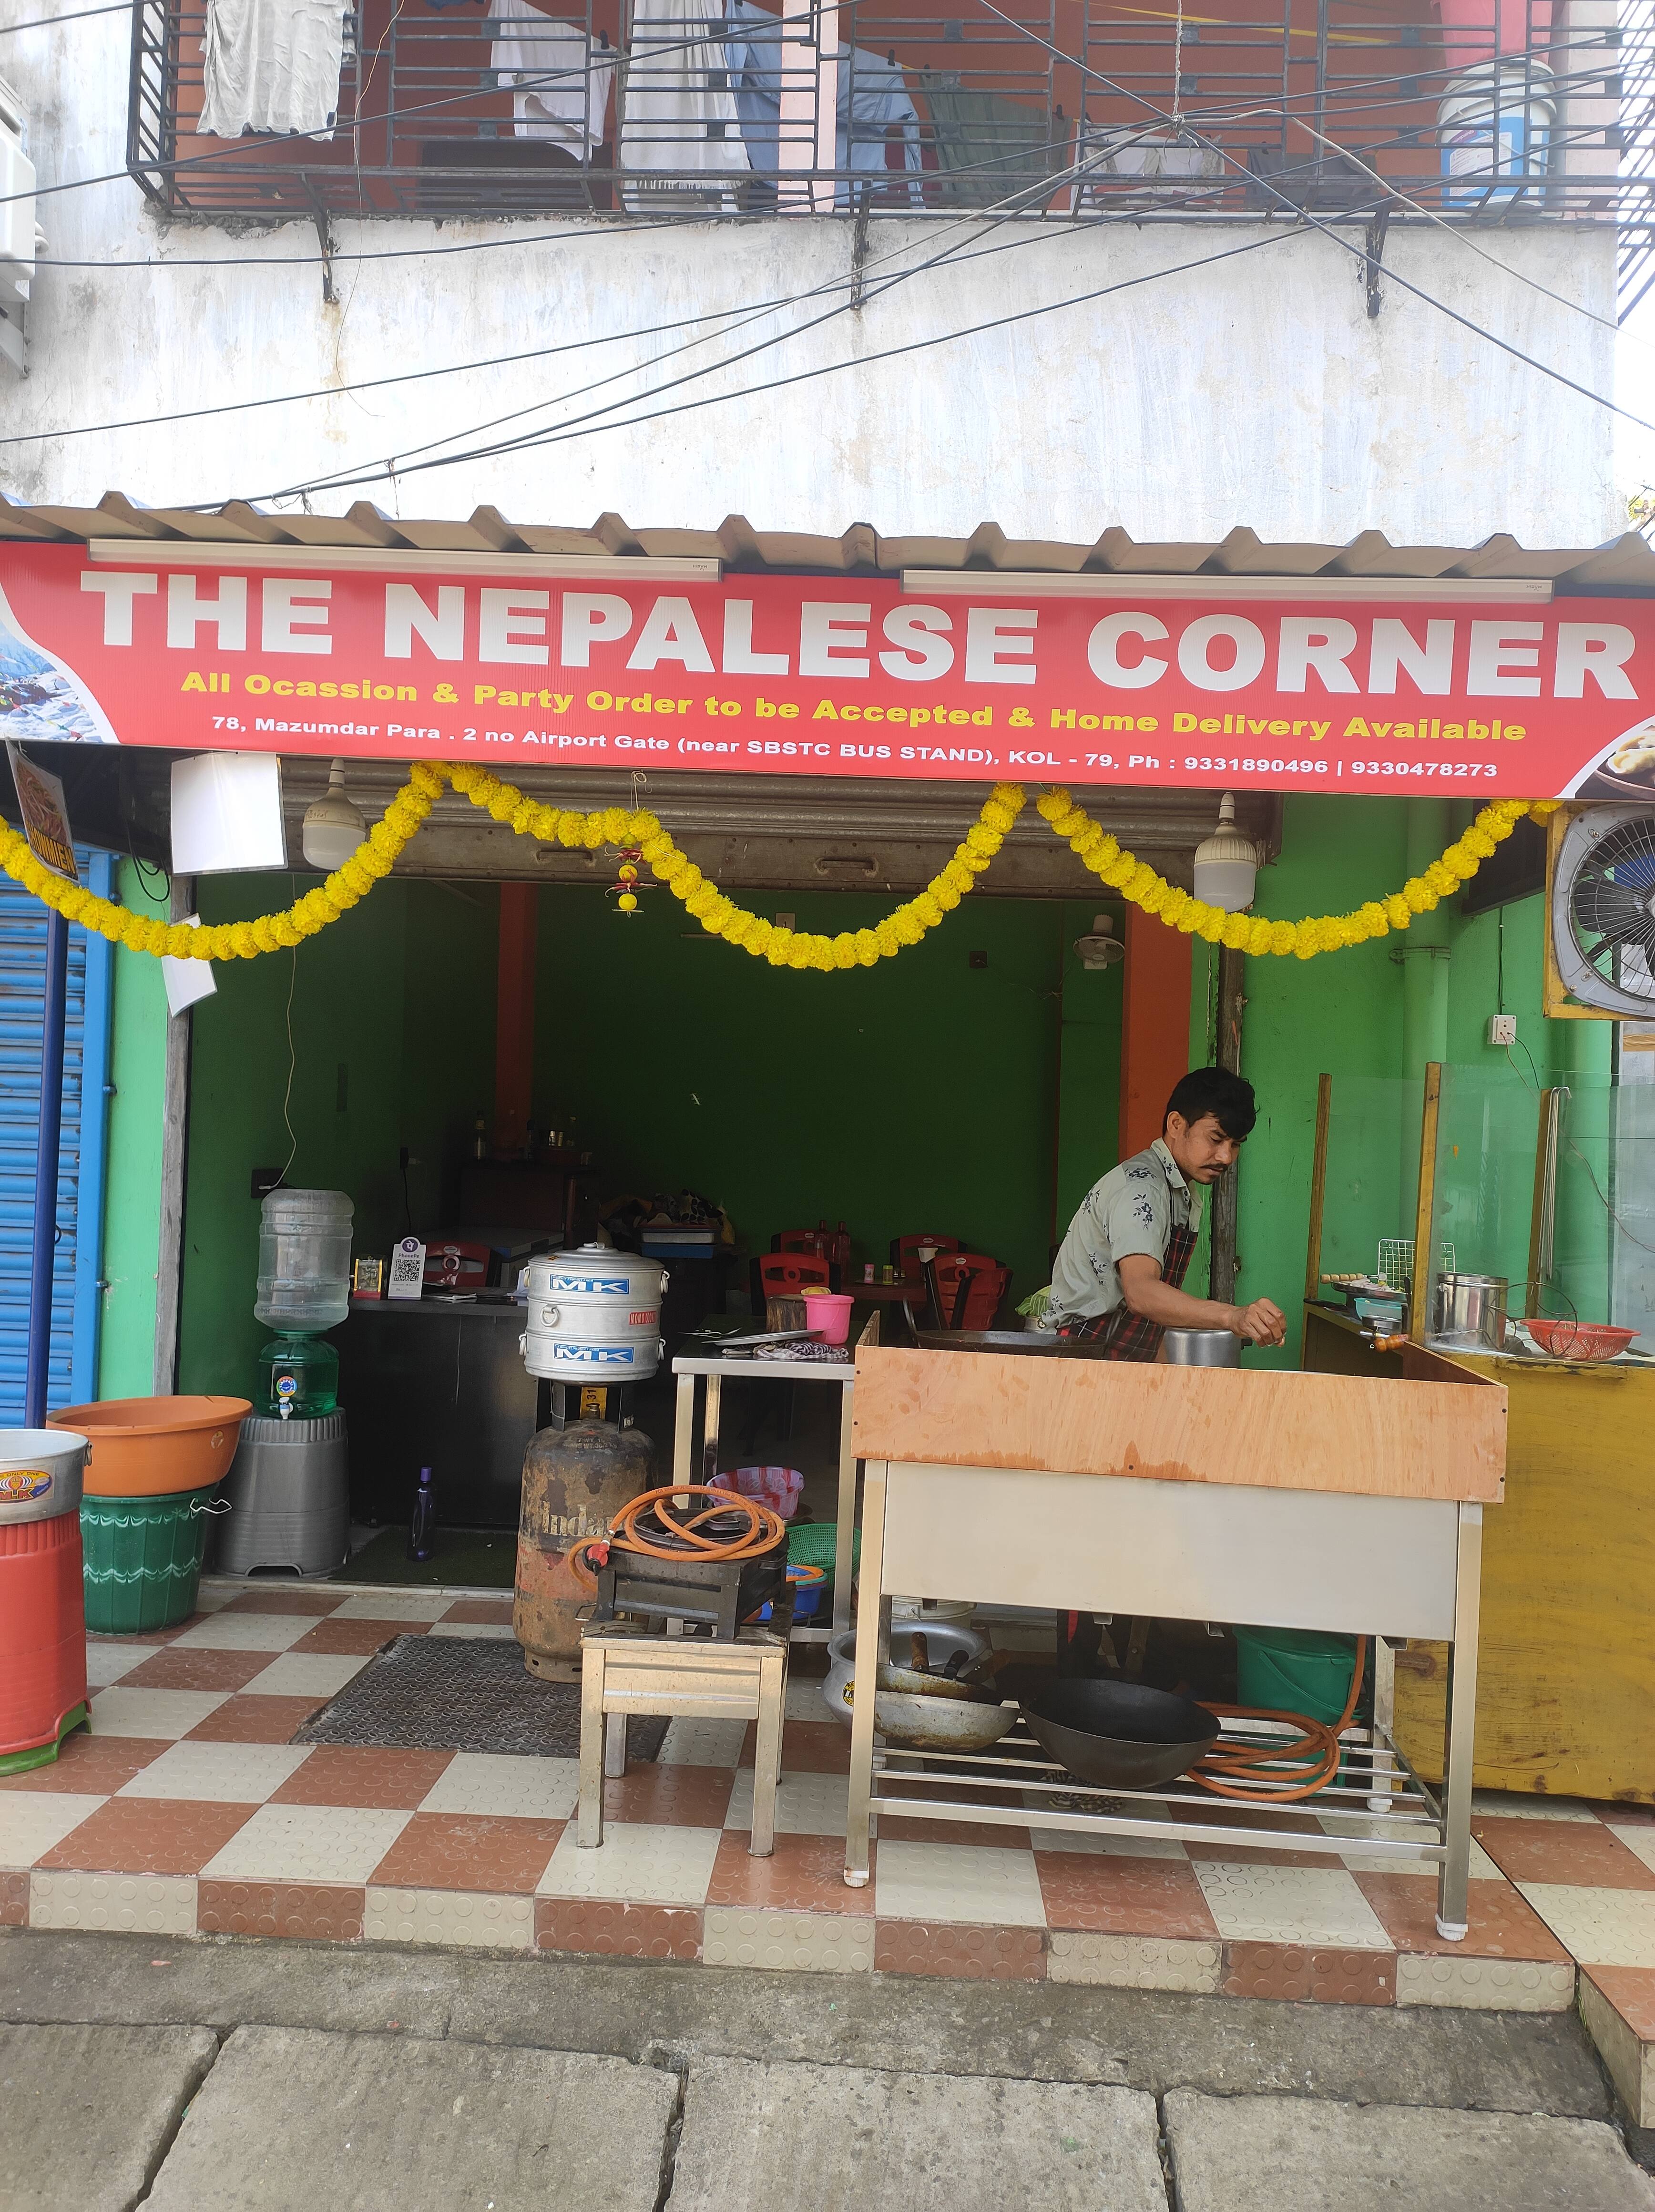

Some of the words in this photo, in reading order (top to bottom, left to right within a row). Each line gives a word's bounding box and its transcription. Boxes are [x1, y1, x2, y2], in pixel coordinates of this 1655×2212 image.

[81, 575, 332, 654] THE
[385, 584, 1038, 684] NEPALESE
[1088, 617, 1638, 699] CORNER
[183, 674, 229, 691] All
[246, 676, 416, 701] Ocassion
[434, 685, 458, 702] &
[476, 686, 573, 714] Party
[587, 692, 693, 713] Order
[705, 697, 741, 716] to
[756, 698, 799, 718] be
[813, 701, 991, 727] Accepted
[1009, 707, 1033, 727] &
[1052, 710, 1157, 731] Home
[1175, 714, 1329, 741] Delivery
[1344, 718, 1525, 740] Available
[213, 717, 245, 732] 78,
[255, 718, 379, 736] Mazumdar
[385, 725, 440, 738] Para
[463, 728, 476, 740] 2
[486, 732, 514, 742] no
[522, 731, 606, 748] Airport
[615, 735, 669, 749] Gate
[678, 738, 739, 753] (near
[747, 741, 830, 756] SBSTC
[840, 745, 891, 758] BUS
[900, 747, 999, 765] STAND),
[1010, 751, 1061, 765] KOL
[1085, 754, 1118, 769] 79,
[1129, 756, 1159, 768] Ph
[1170, 759, 1175, 768] :
[1185, 758, 1328, 773] 9331890496
[1352, 762, 1496, 777] 9330478273
[630, 1313, 644, 1324] MOMO
